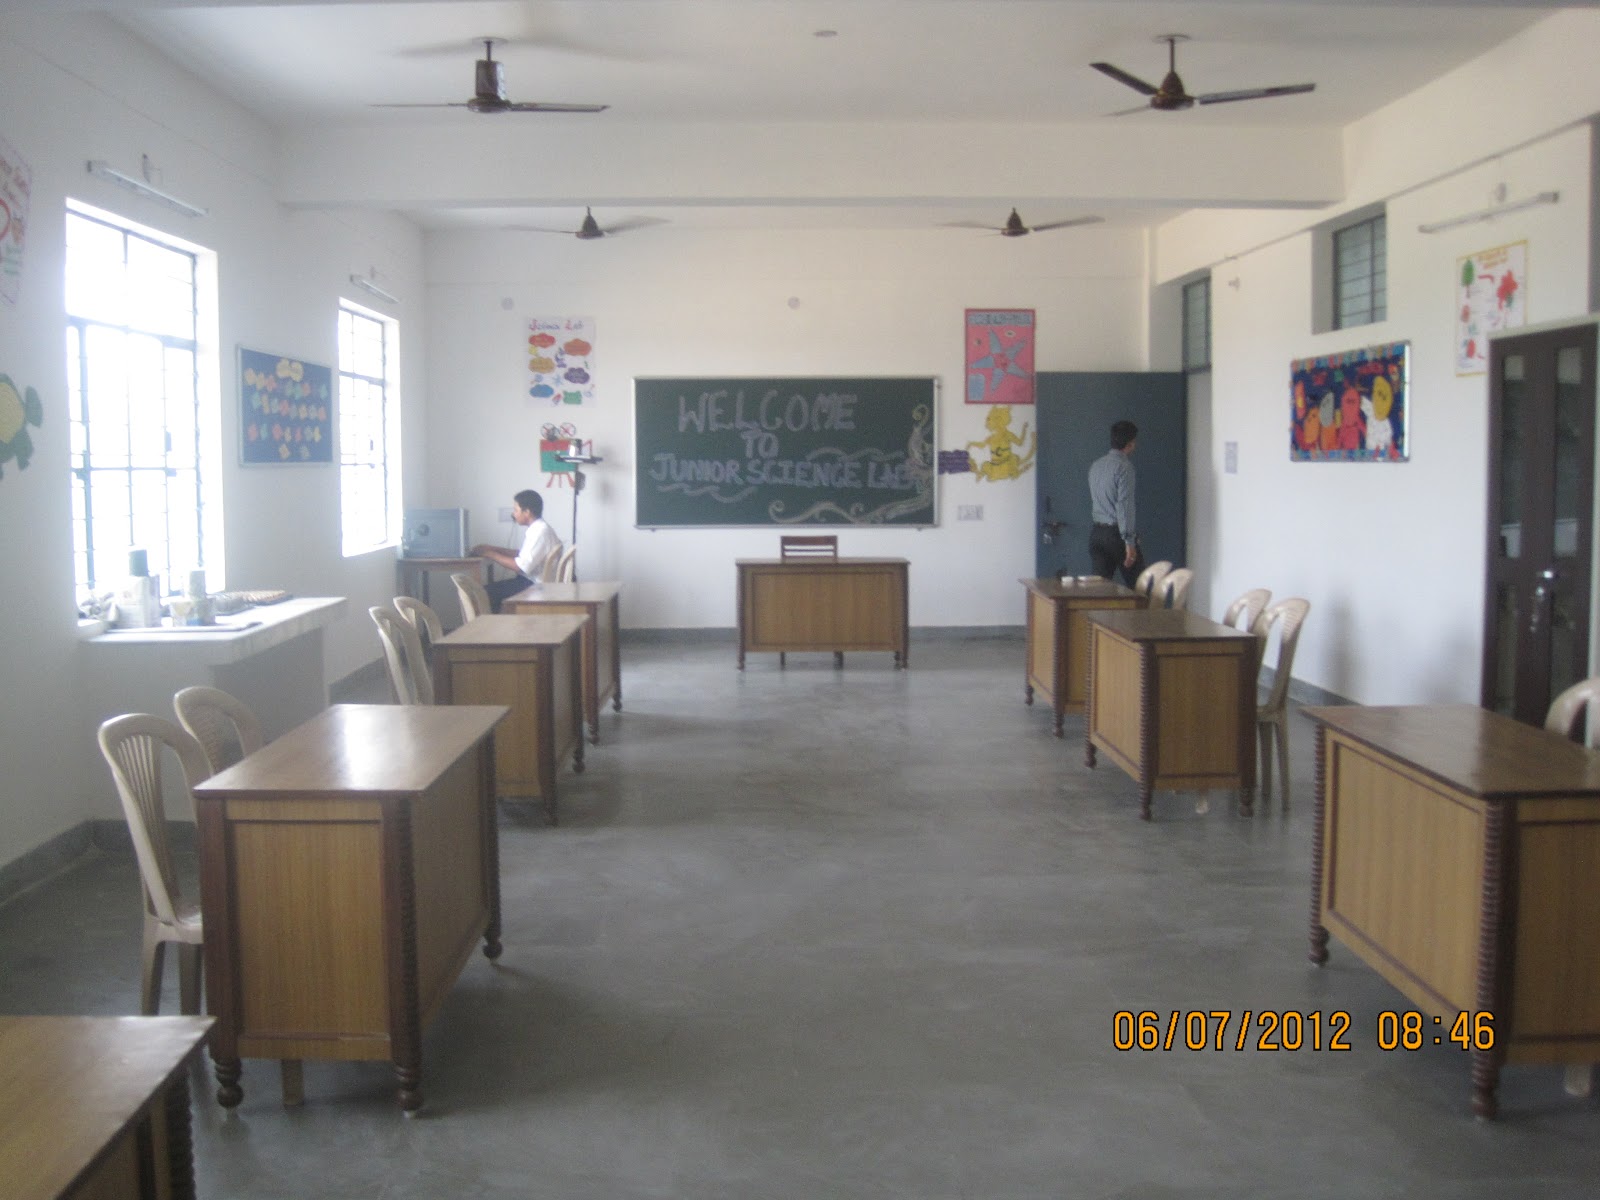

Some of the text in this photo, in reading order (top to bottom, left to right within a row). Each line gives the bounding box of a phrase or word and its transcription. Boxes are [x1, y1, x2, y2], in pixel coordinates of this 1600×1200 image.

[678, 389, 857, 433] WELCOME
[740, 429, 779, 458] TO
[651, 453, 744, 485] JUNIOR
[747, 458, 862, 488] SCIENCE
